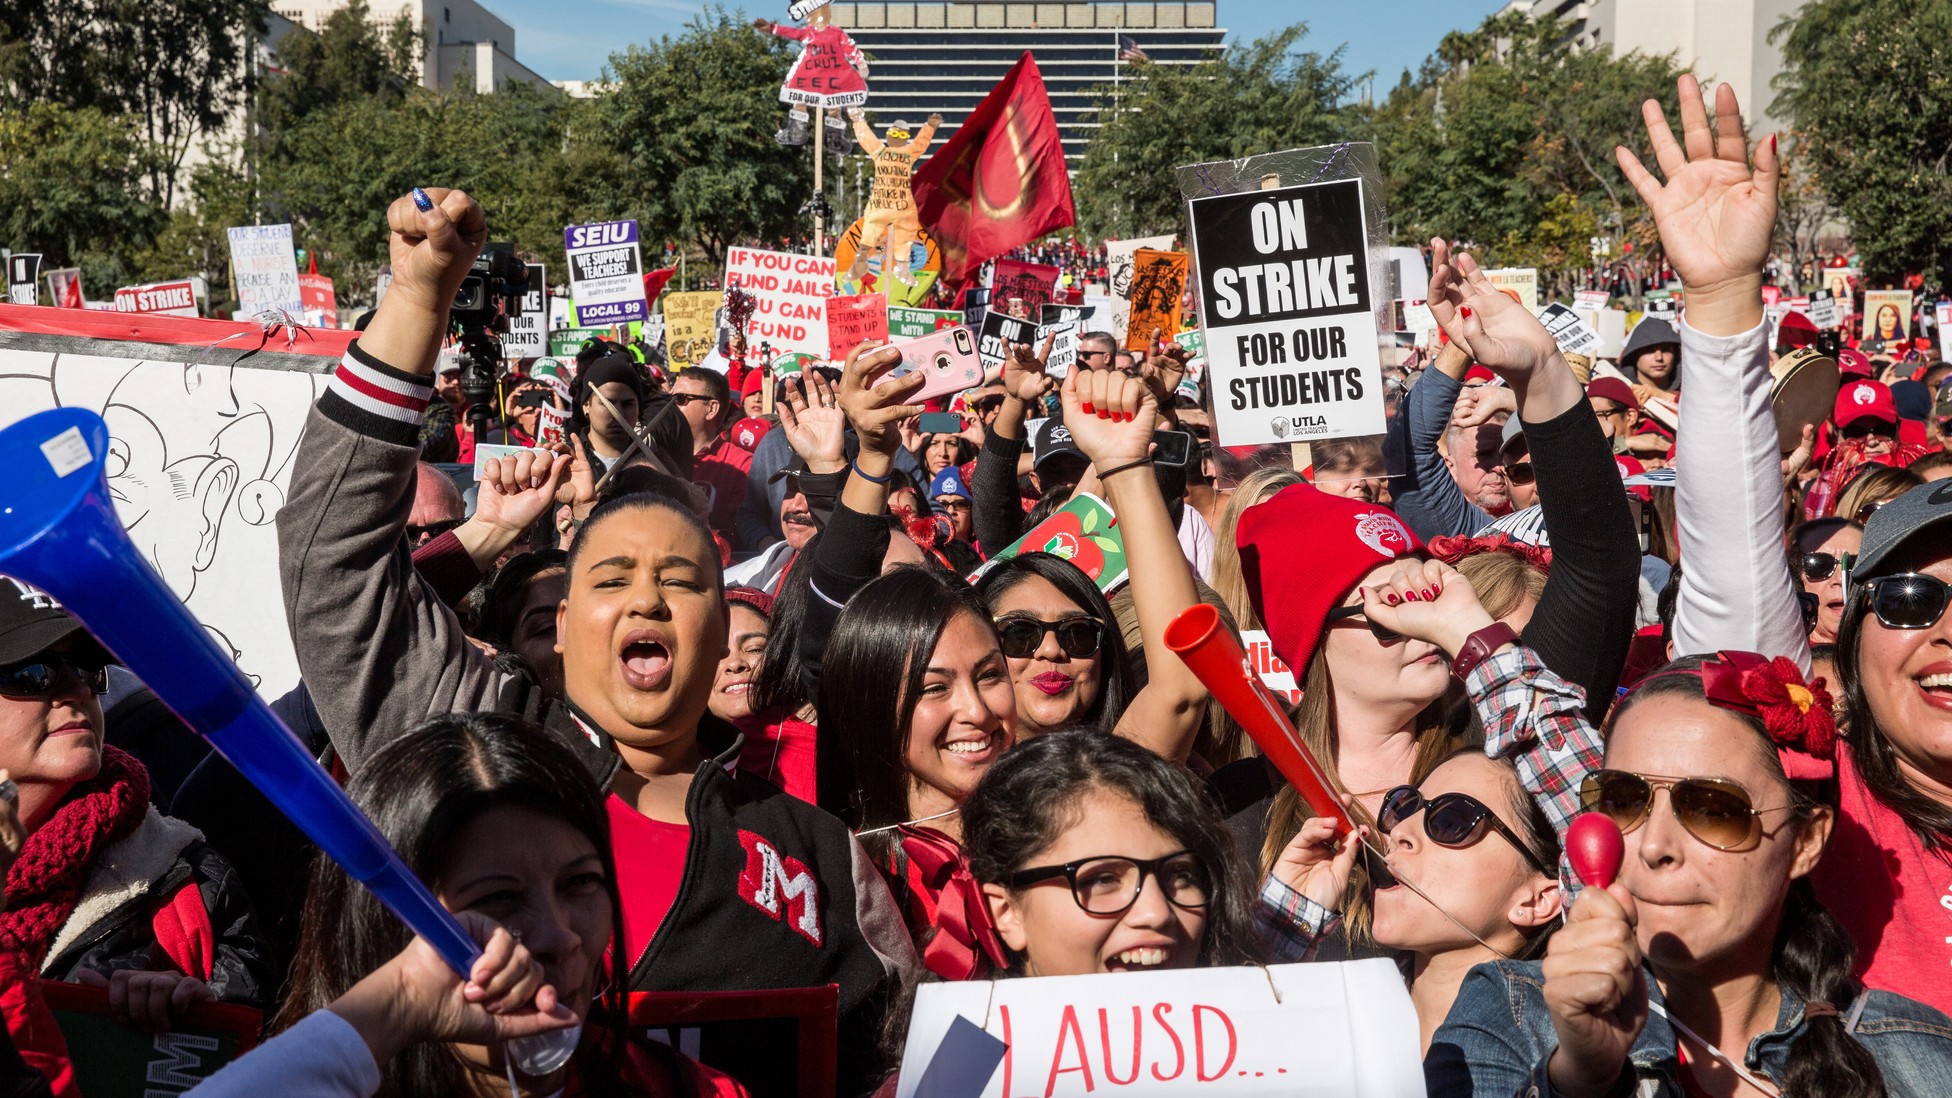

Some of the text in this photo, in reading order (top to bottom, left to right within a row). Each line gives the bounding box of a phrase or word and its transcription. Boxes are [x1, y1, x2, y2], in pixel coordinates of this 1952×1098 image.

[805, 57, 841, 70] CRUZ
[789, 92, 864, 105] FOR OUR STUDENTS
[572, 222, 630, 248] SEIU
[1251, 199, 1308, 254] ON
[234, 242, 283, 257] DESERVE
[576, 248, 630, 268] WE SUPPORT
[252, 256, 291, 271] NURSE
[731, 250, 835, 277] IF YOU CAN
[1111, 254, 1125, 264] LOS
[15, 259, 26, 282] ON
[280, 271, 295, 285] AN
[582, 262, 628, 280] TEACHERS!
[271, 286, 291, 300] DAY
[727, 271, 834, 298] FUND JAILS
[1213, 255, 1359, 319] STRIKE
[11, 283, 36, 305] STRIKE
[116, 287, 192, 312] ON STRIKE
[582, 302, 640, 318] LOCAL 99
[779, 301, 821, 321] CAN
[828, 309, 877, 323] STUDENTS
[889, 310, 936, 325] WE STAND
[513, 317, 534, 329] OUR
[672, 324, 683, 337] is
[684, 325, 693, 335] a
[747, 320, 807, 342] FUND
[864, 321, 878, 333] UP
[900, 324, 924, 336] WITH
[1000, 319, 1022, 341] ON
[500, 332, 539, 345] UDENTS
[1055, 335, 1069, 348] OUR
[1237, 326, 1347, 368] FOR OUR
[1229, 367, 1364, 411] STUDENTS
[1292, 415, 1327, 428] UTLA
[755, 842, 820, 942] M
[1000, 1001, 1287, 1098] LAUSD...
